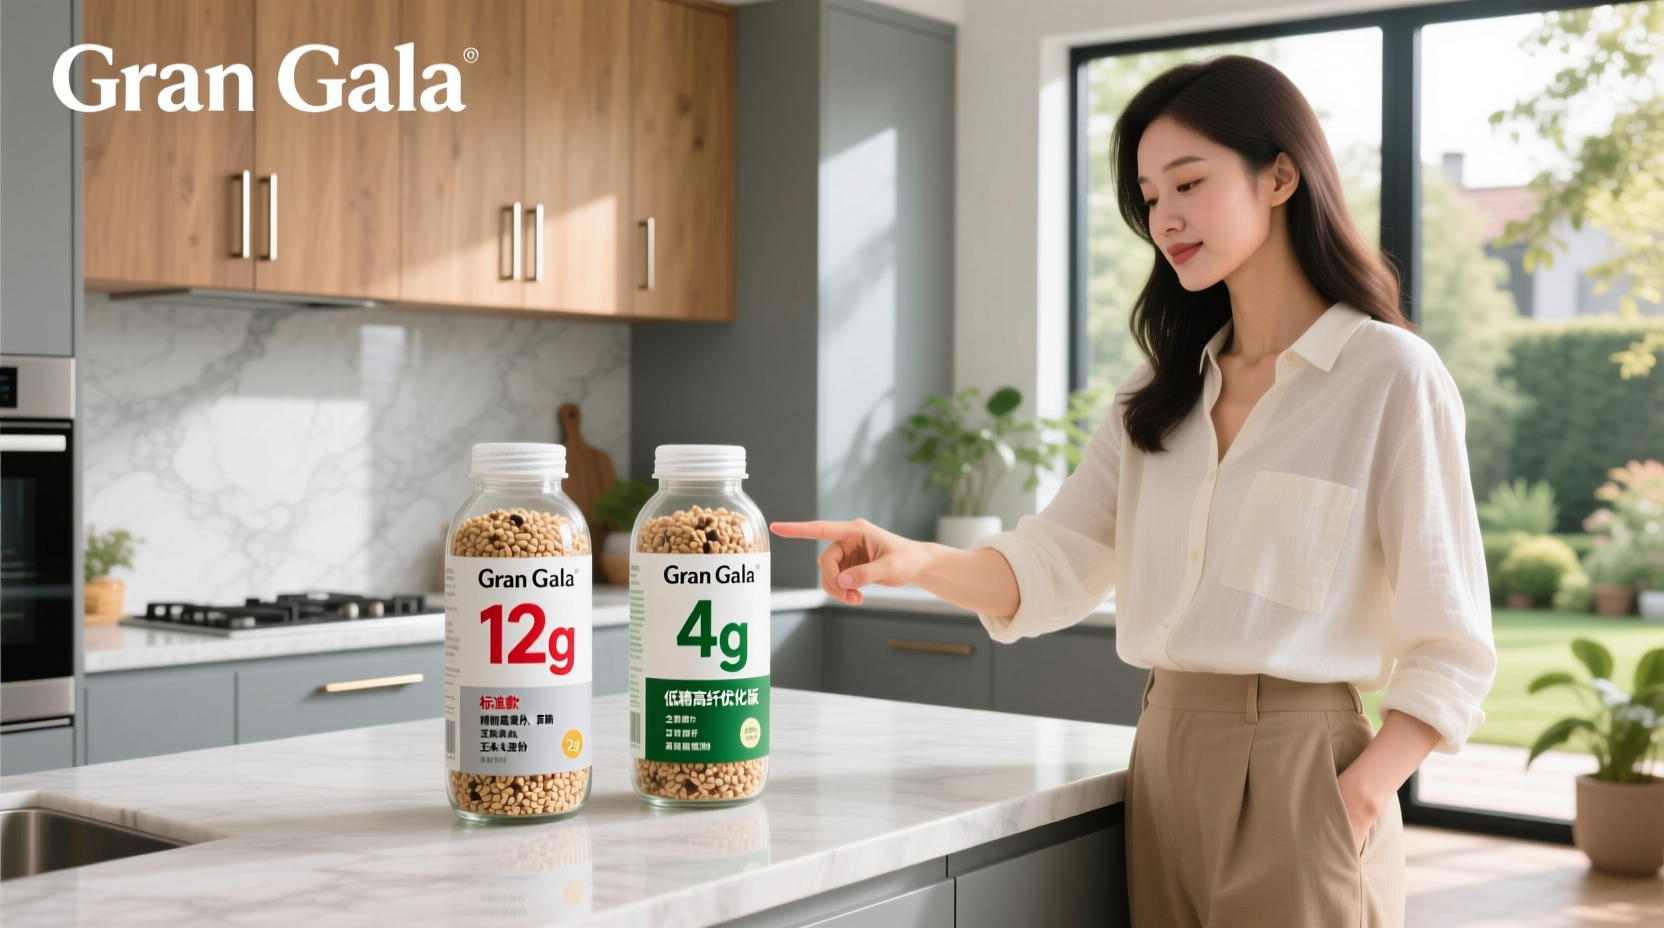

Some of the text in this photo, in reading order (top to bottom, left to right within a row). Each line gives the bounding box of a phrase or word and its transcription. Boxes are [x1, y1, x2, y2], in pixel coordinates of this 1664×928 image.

[478, 568, 527, 588] Gran
[663, 563, 755, 584] Gran Gala
[480, 602, 576, 676] 12g
[676, 599, 748, 673] 4g
